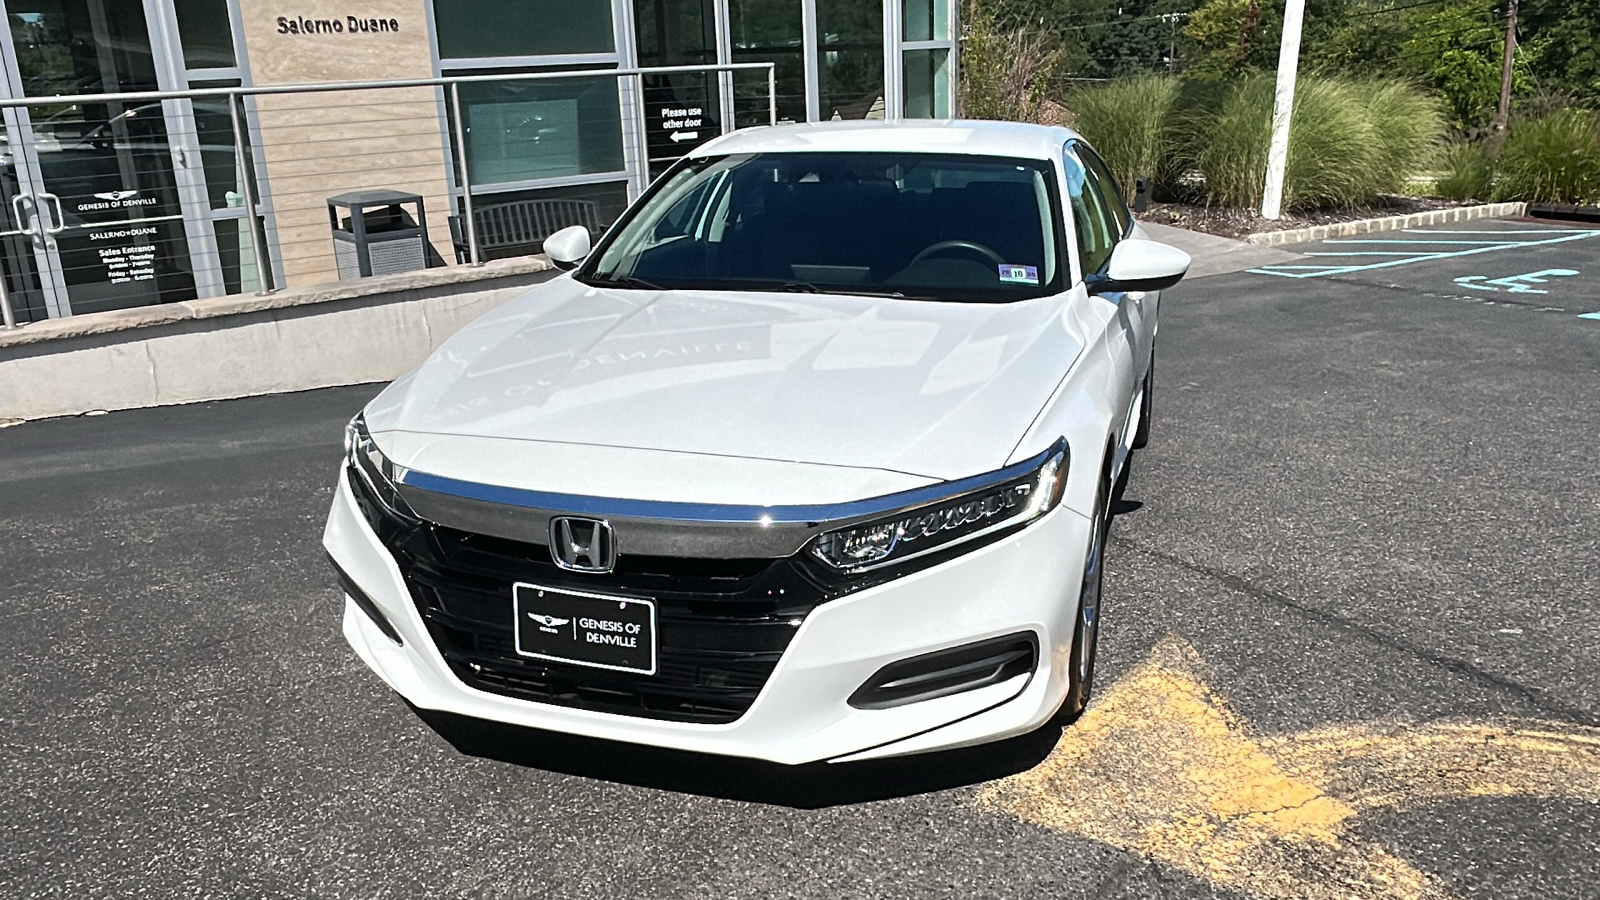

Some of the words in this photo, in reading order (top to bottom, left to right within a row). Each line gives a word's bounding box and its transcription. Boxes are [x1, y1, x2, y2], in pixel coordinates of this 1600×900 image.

[276, 15, 344, 34] Salerno
[346, 15, 399, 33] Duane
[661, 108, 687, 118] Please
[688, 108, 702, 116] use
[662, 119, 683, 129] other
[684, 118, 702, 127] door
[78, 201, 109, 211] GENESIS
[123, 198, 156, 206] DENVILLE
[90, 231, 125, 240] SALERNO
[131, 227, 157, 235] DUANE
[98, 248, 121, 257] Sales
[122, 245, 155, 254] Entrance
[579, 617, 623, 632] GENESIS
[624, 622, 641, 635] OF
[586, 631, 637, 648] DENVILLE
